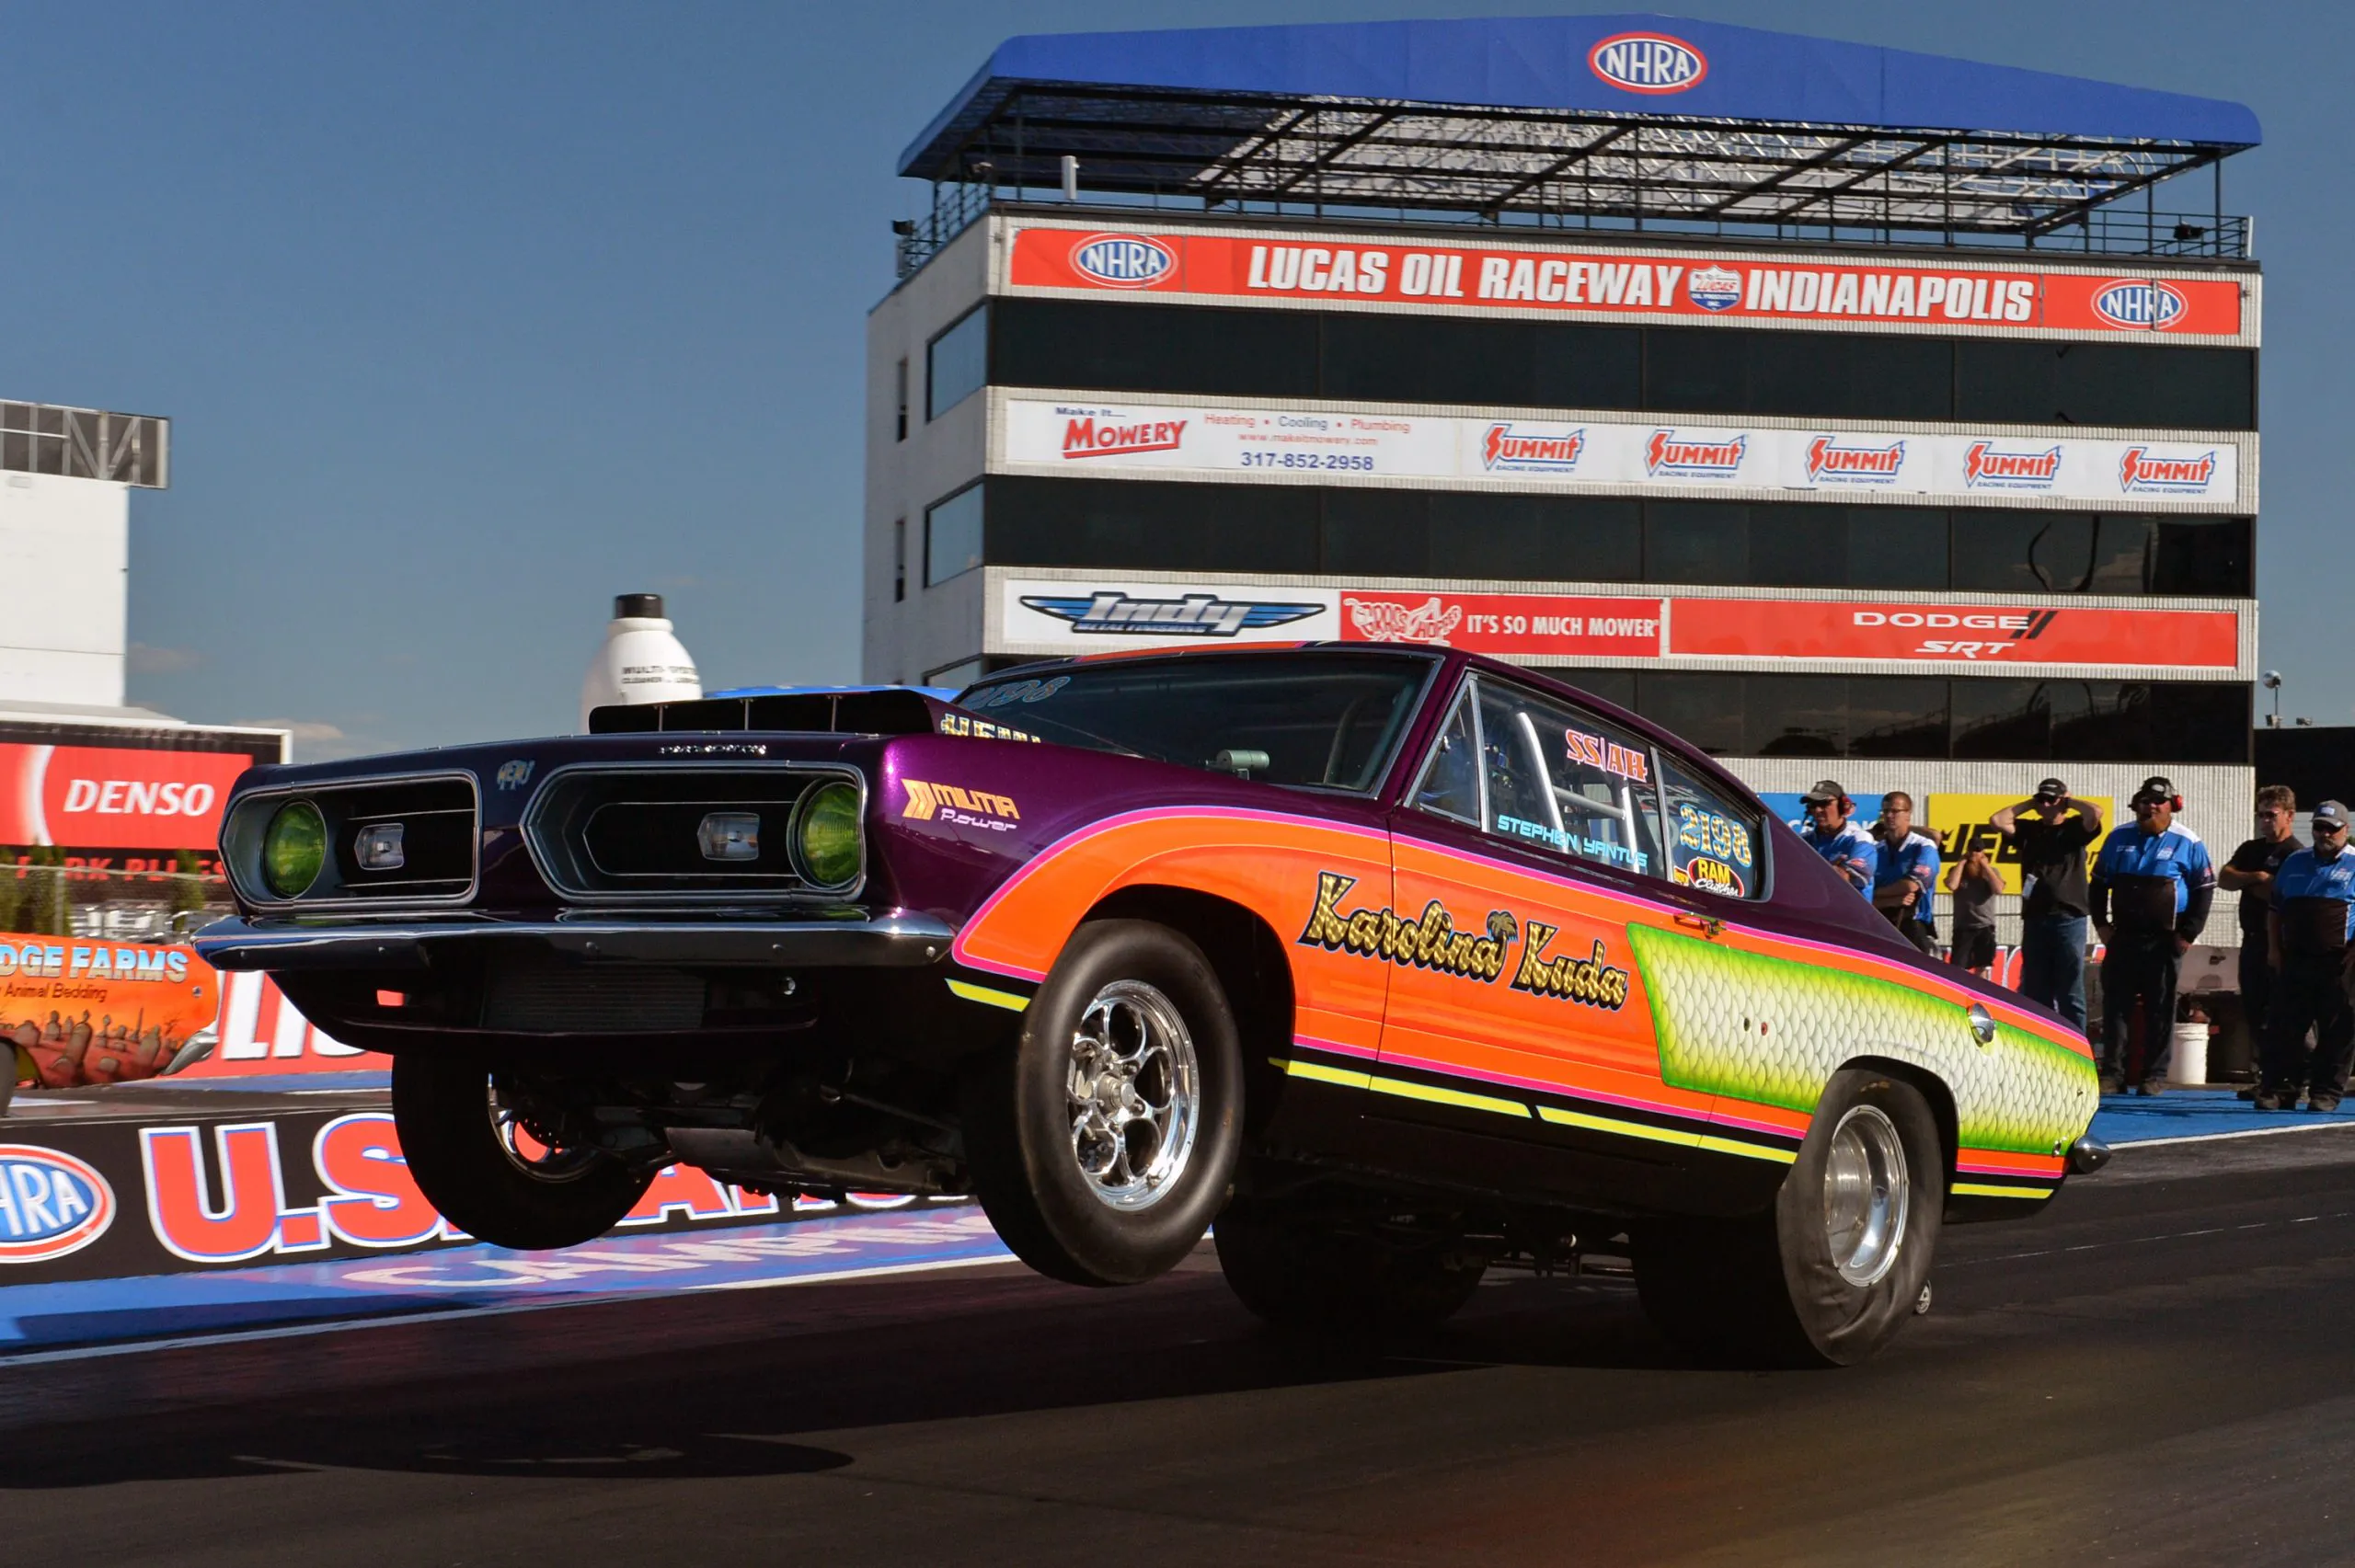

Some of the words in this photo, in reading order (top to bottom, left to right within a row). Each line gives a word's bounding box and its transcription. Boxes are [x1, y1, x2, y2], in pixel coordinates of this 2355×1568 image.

[1606, 42, 1692, 84] NHRA
[1086, 243, 1163, 278] NHRA
[1247, 245, 1389, 293] LUCAS
[1400, 253, 1465, 298] OIL
[1477, 257, 1684, 307] RACEWAY
[1745, 269, 2035, 321] INDIANAPOLIS
[2103, 287, 2174, 320] NHRA
[1204, 414, 1256, 429] Heating
[1278, 416, 1328, 431] Cooling
[1350, 418, 1411, 434] Plumbing
[1241, 452, 1374, 471] 317-852-2958
[1078, 595, 1254, 634] Indy
[1467, 614, 1499, 635] IT'S
[1503, 615, 1527, 635] SO
[1532, 616, 1583, 636] MUCH
[1853, 611, 2030, 630] DODGE
[1914, 640, 2016, 659] SRT
[63, 778, 214, 817] DENSO
[940, 807, 1017, 832] Power
[1680, 803, 1752, 868] 2198
[1497, 814, 1580, 850] STEPHEN
[1583, 837, 1648, 867] YANTUS
[1697, 858, 1730, 887] RAM
[1296, 869, 1513, 984] Karolina
[1510, 920, 1630, 1011] Kuda
[69, 946, 190, 984] FARMS
[4, 981, 48, 999] Animal
[52, 982, 109, 1003] Bedding
